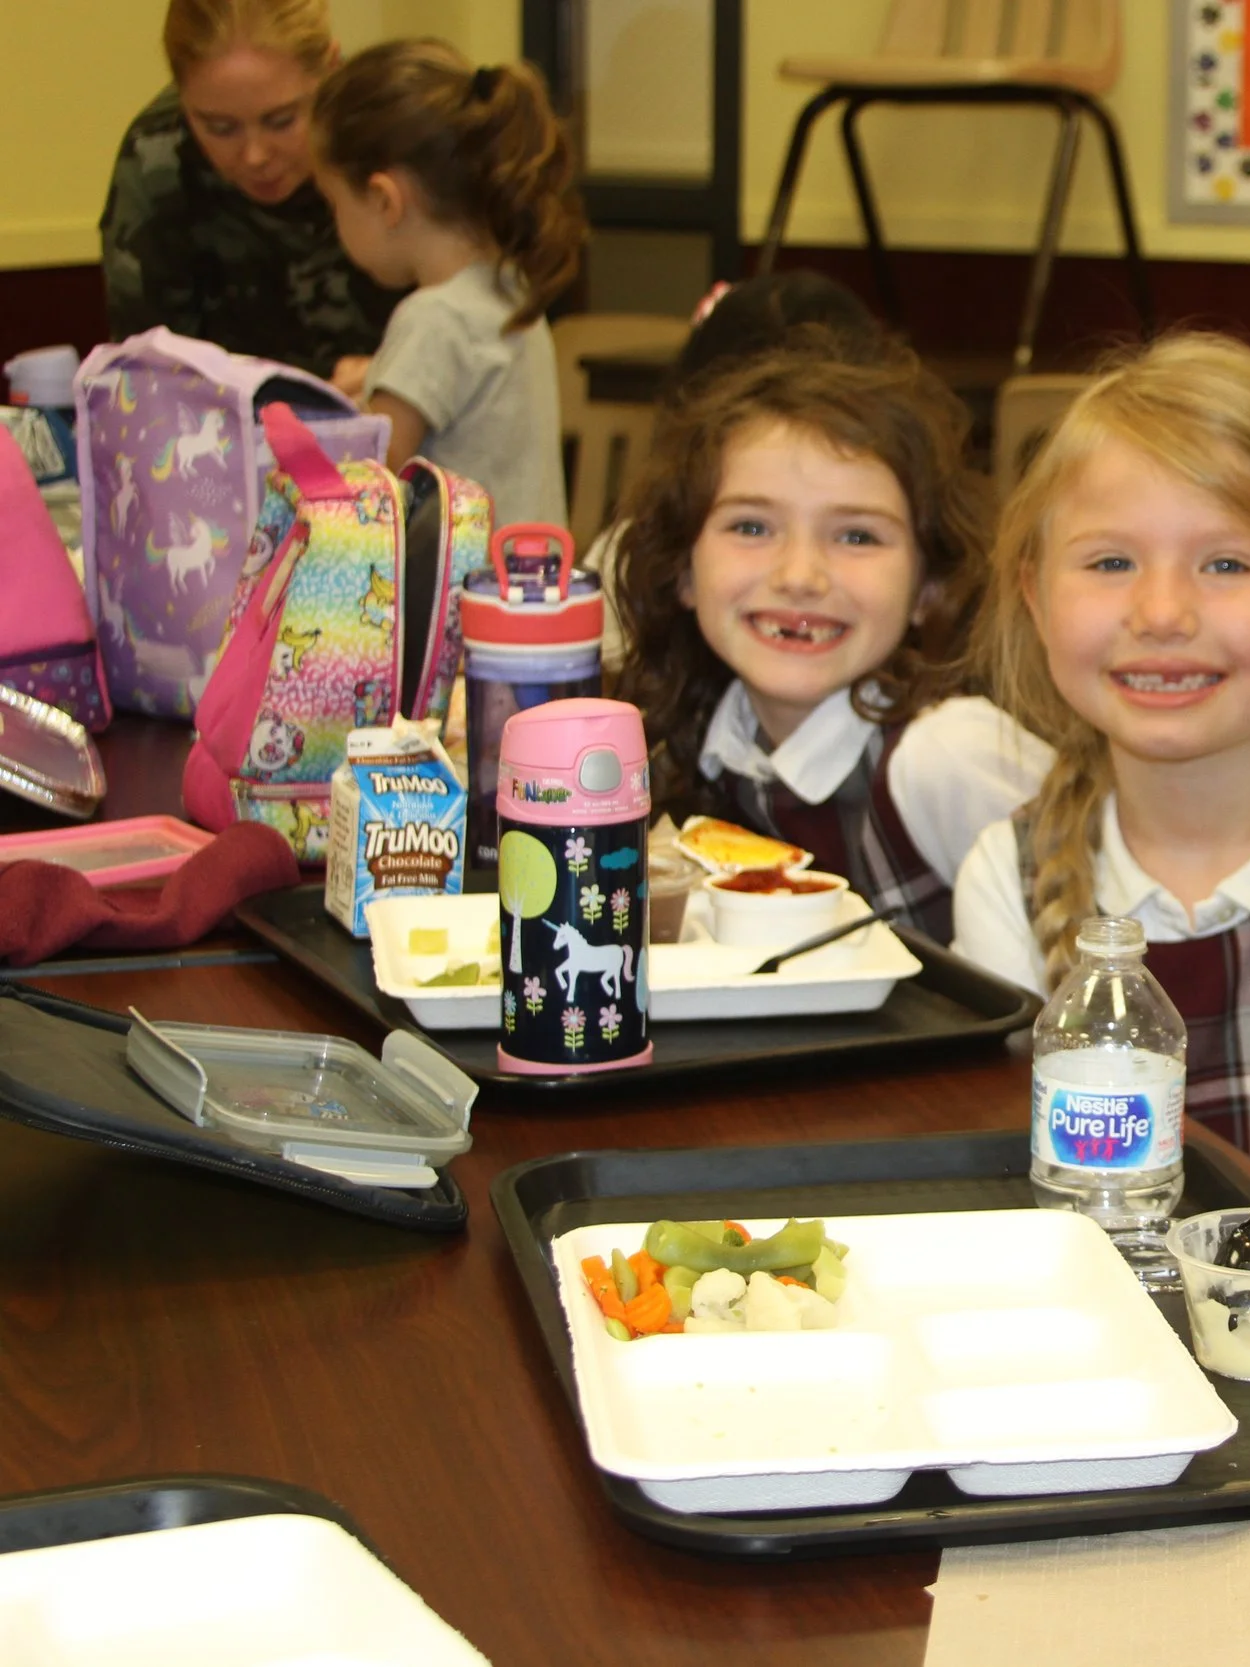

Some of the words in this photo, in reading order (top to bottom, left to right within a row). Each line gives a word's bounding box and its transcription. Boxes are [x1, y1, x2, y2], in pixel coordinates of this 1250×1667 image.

[370, 772, 448, 796] TruMoo
[364, 821, 459, 861] TruMoo
[378, 855, 442, 869] Chocolate
[478, 845, 498, 860] con
[382, 873, 396, 885] Fat
[397, 873, 418, 883] Free
[420, 872, 439, 885] Milk
[1052, 1108, 1105, 1138] Pure
[1109, 1114, 1150, 1148] Life
